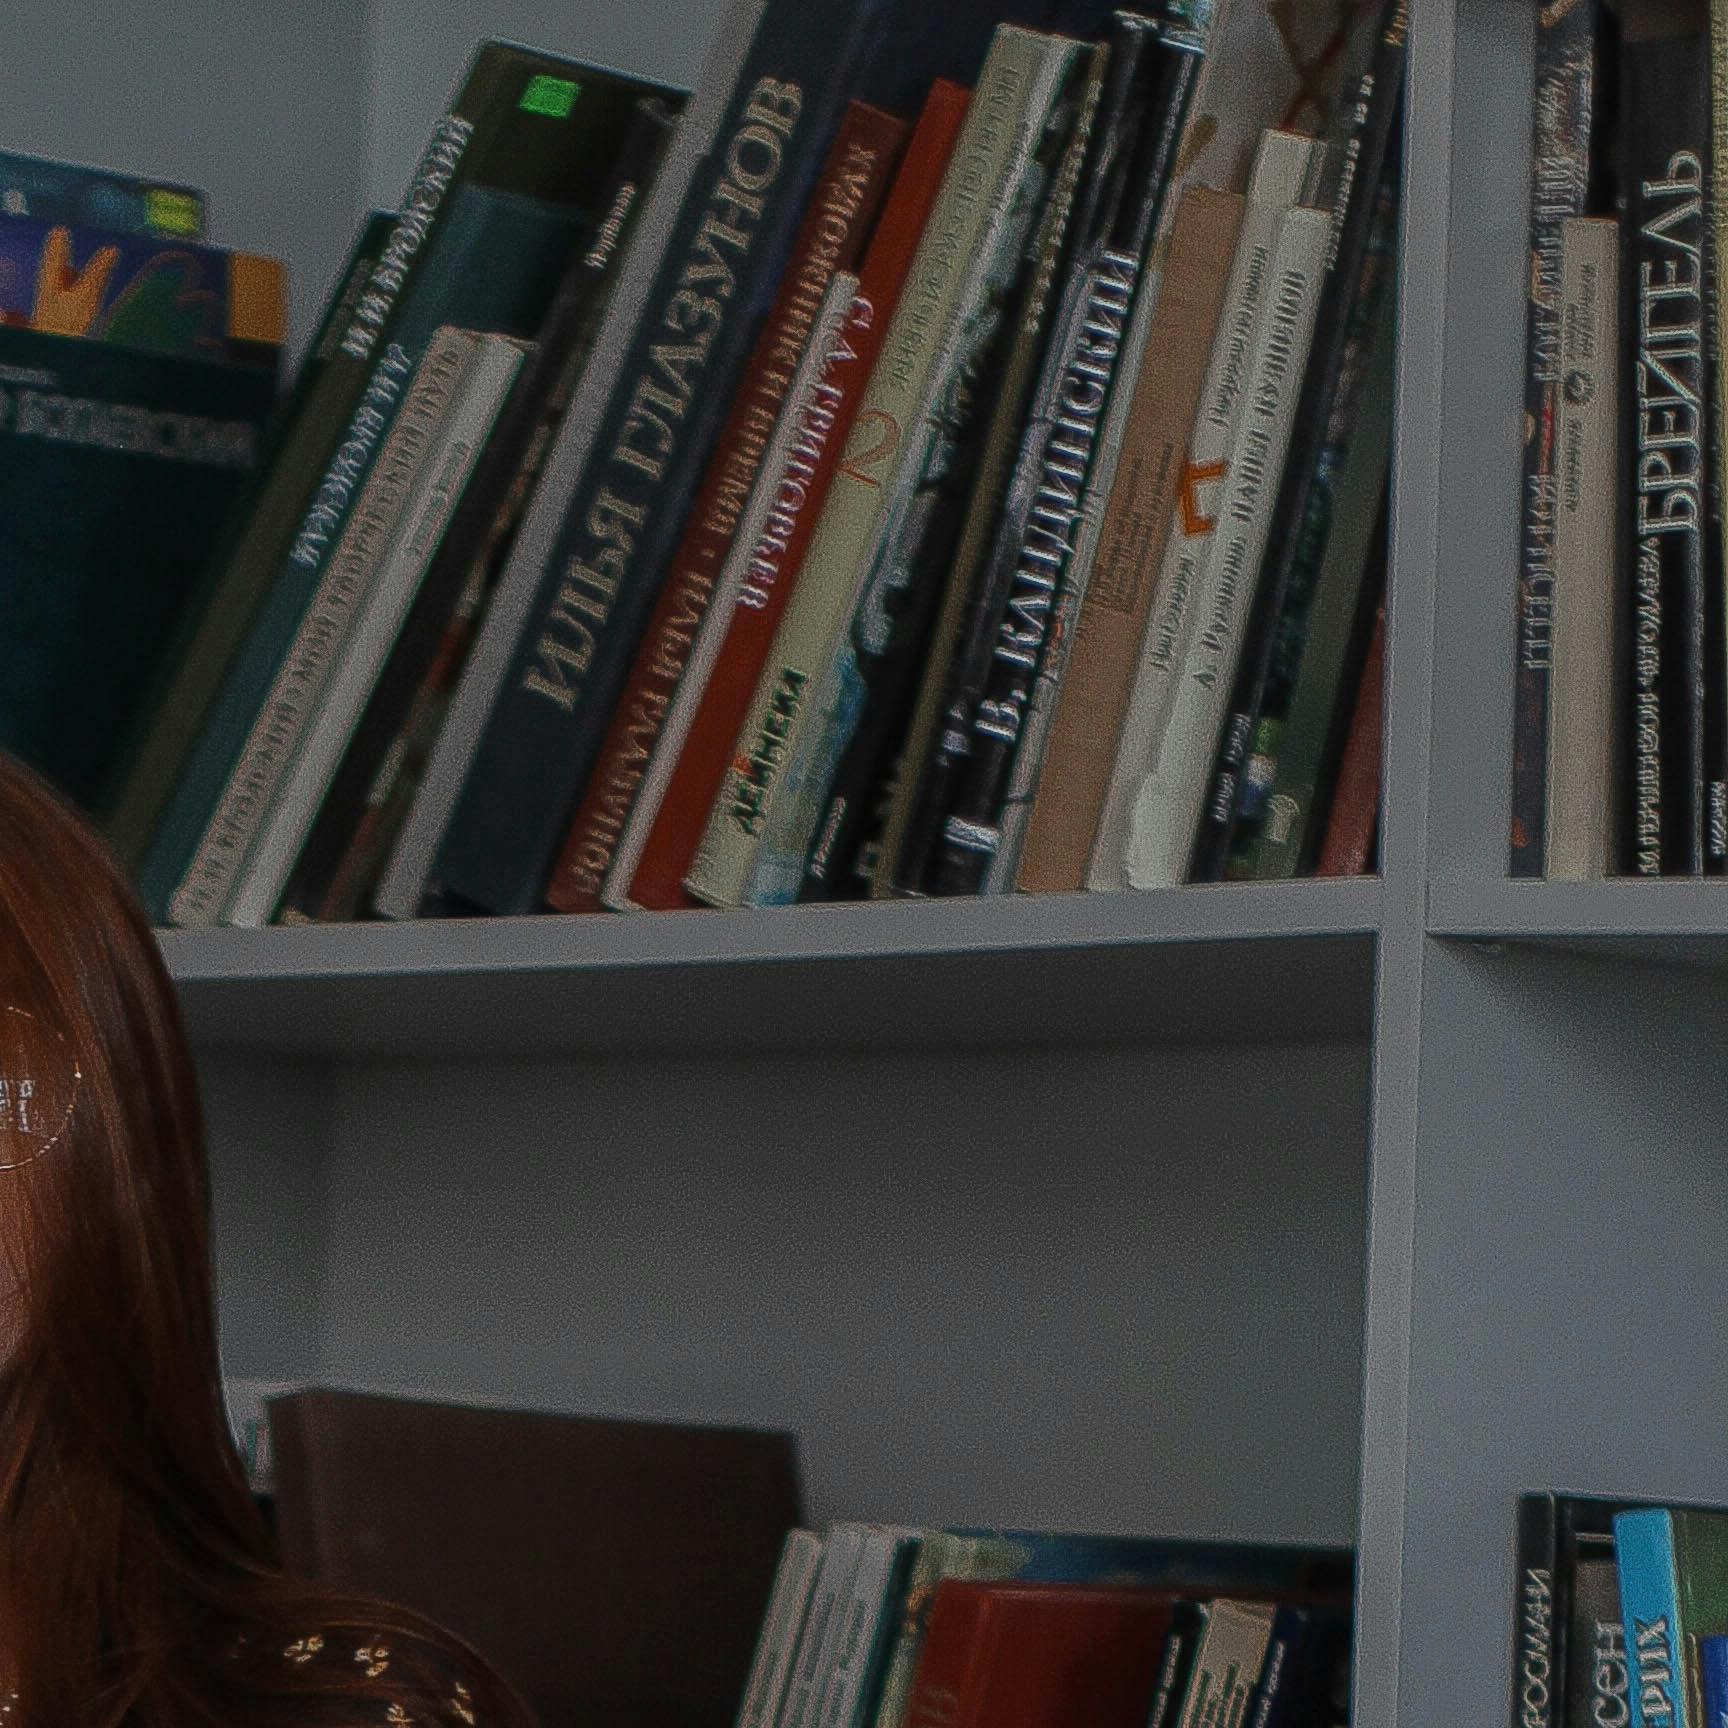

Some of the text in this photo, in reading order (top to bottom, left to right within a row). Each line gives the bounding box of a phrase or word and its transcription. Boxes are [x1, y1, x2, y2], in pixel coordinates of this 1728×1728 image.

[518, 73, 819, 706] ИЛЬЯ ГЛАЗУНОВ
[986, 256, 1150, 672] КАНДИНСКИЙ
[1633, 148, 1706, 534] БРЕЙГЕЛЬ
[724, 666, 811, 837] ДЕЙНЕКА
[969, 677, 1029, 745] В.
